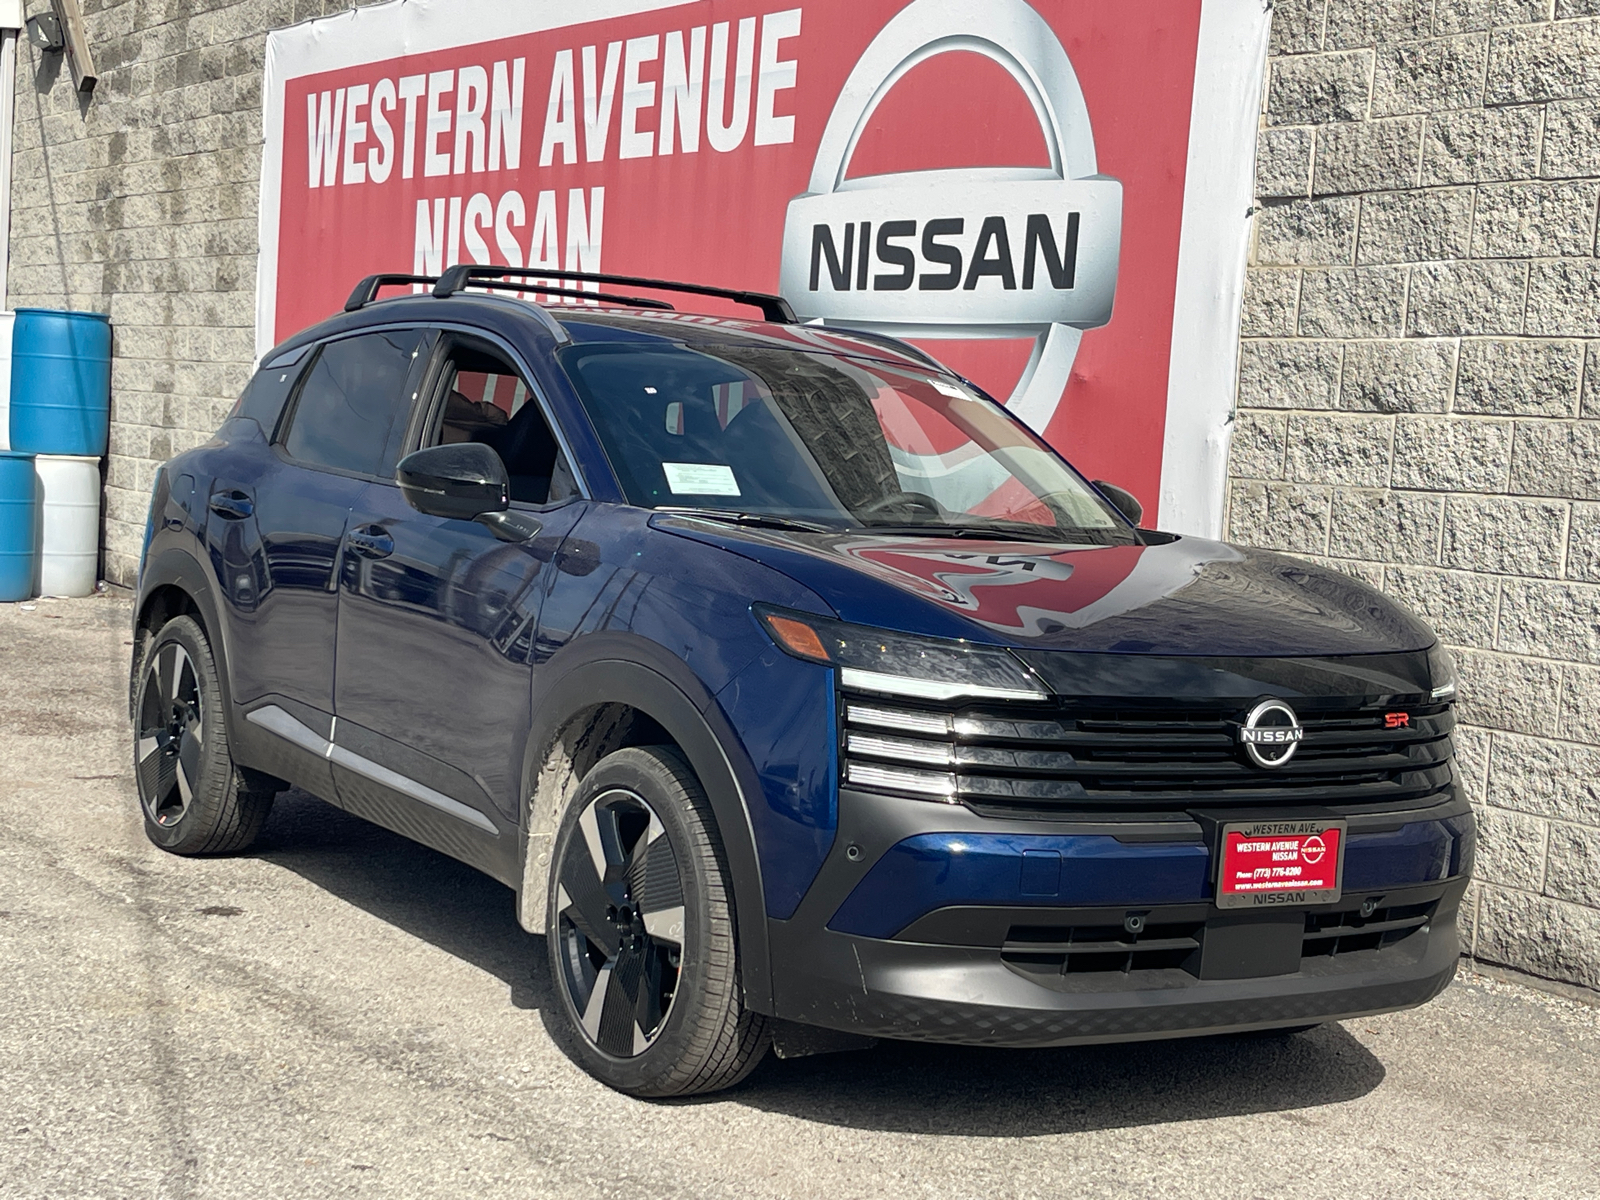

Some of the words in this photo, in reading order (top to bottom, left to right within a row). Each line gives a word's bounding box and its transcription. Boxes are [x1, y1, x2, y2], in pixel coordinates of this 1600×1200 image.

[308, 57, 525, 188] WESTERN
[539, 8, 801, 167] AVENUE
[412, 186, 605, 304] NISSAN
[809, 212, 1080, 291] NISSAN
[1384, 712, 1409, 727] SR
[1242, 729, 1303, 742] NISSAN
[1253, 824, 1296, 834] WESTERN
[1298, 823, 1316, 833] AVE
[1236, 842, 1271, 852] WESTERN
[1271, 841, 1299, 851] AVENUE
[1272, 851, 1298, 861] NISSAN
[1253, 867, 1271, 879] (773)
[1272, 866, 1302, 876] 776-8200
[1253, 892, 1306, 904] NISSAN
